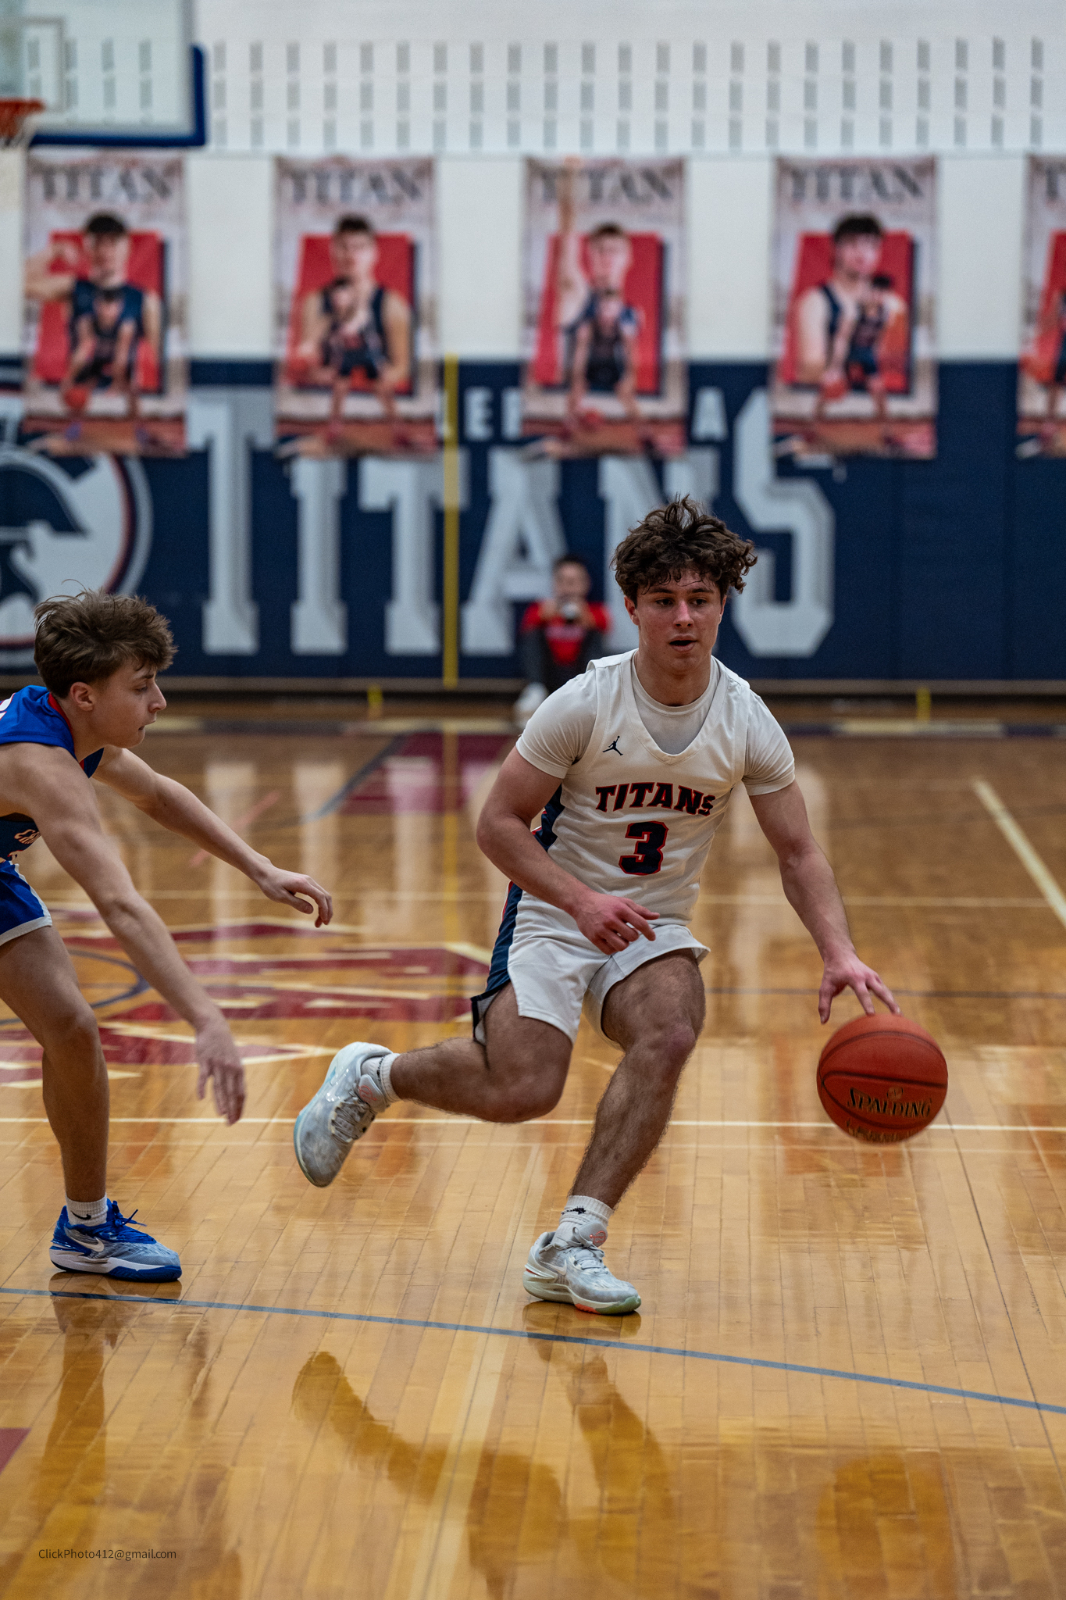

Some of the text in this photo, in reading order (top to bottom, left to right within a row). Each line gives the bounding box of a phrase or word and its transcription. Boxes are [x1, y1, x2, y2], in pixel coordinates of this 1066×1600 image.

[533, 164, 675, 204] TTAN
[595, 782, 716, 816] TITANS
[618, 820, 669, 876] 3
[848, 1087, 932, 1118] SPALDING
